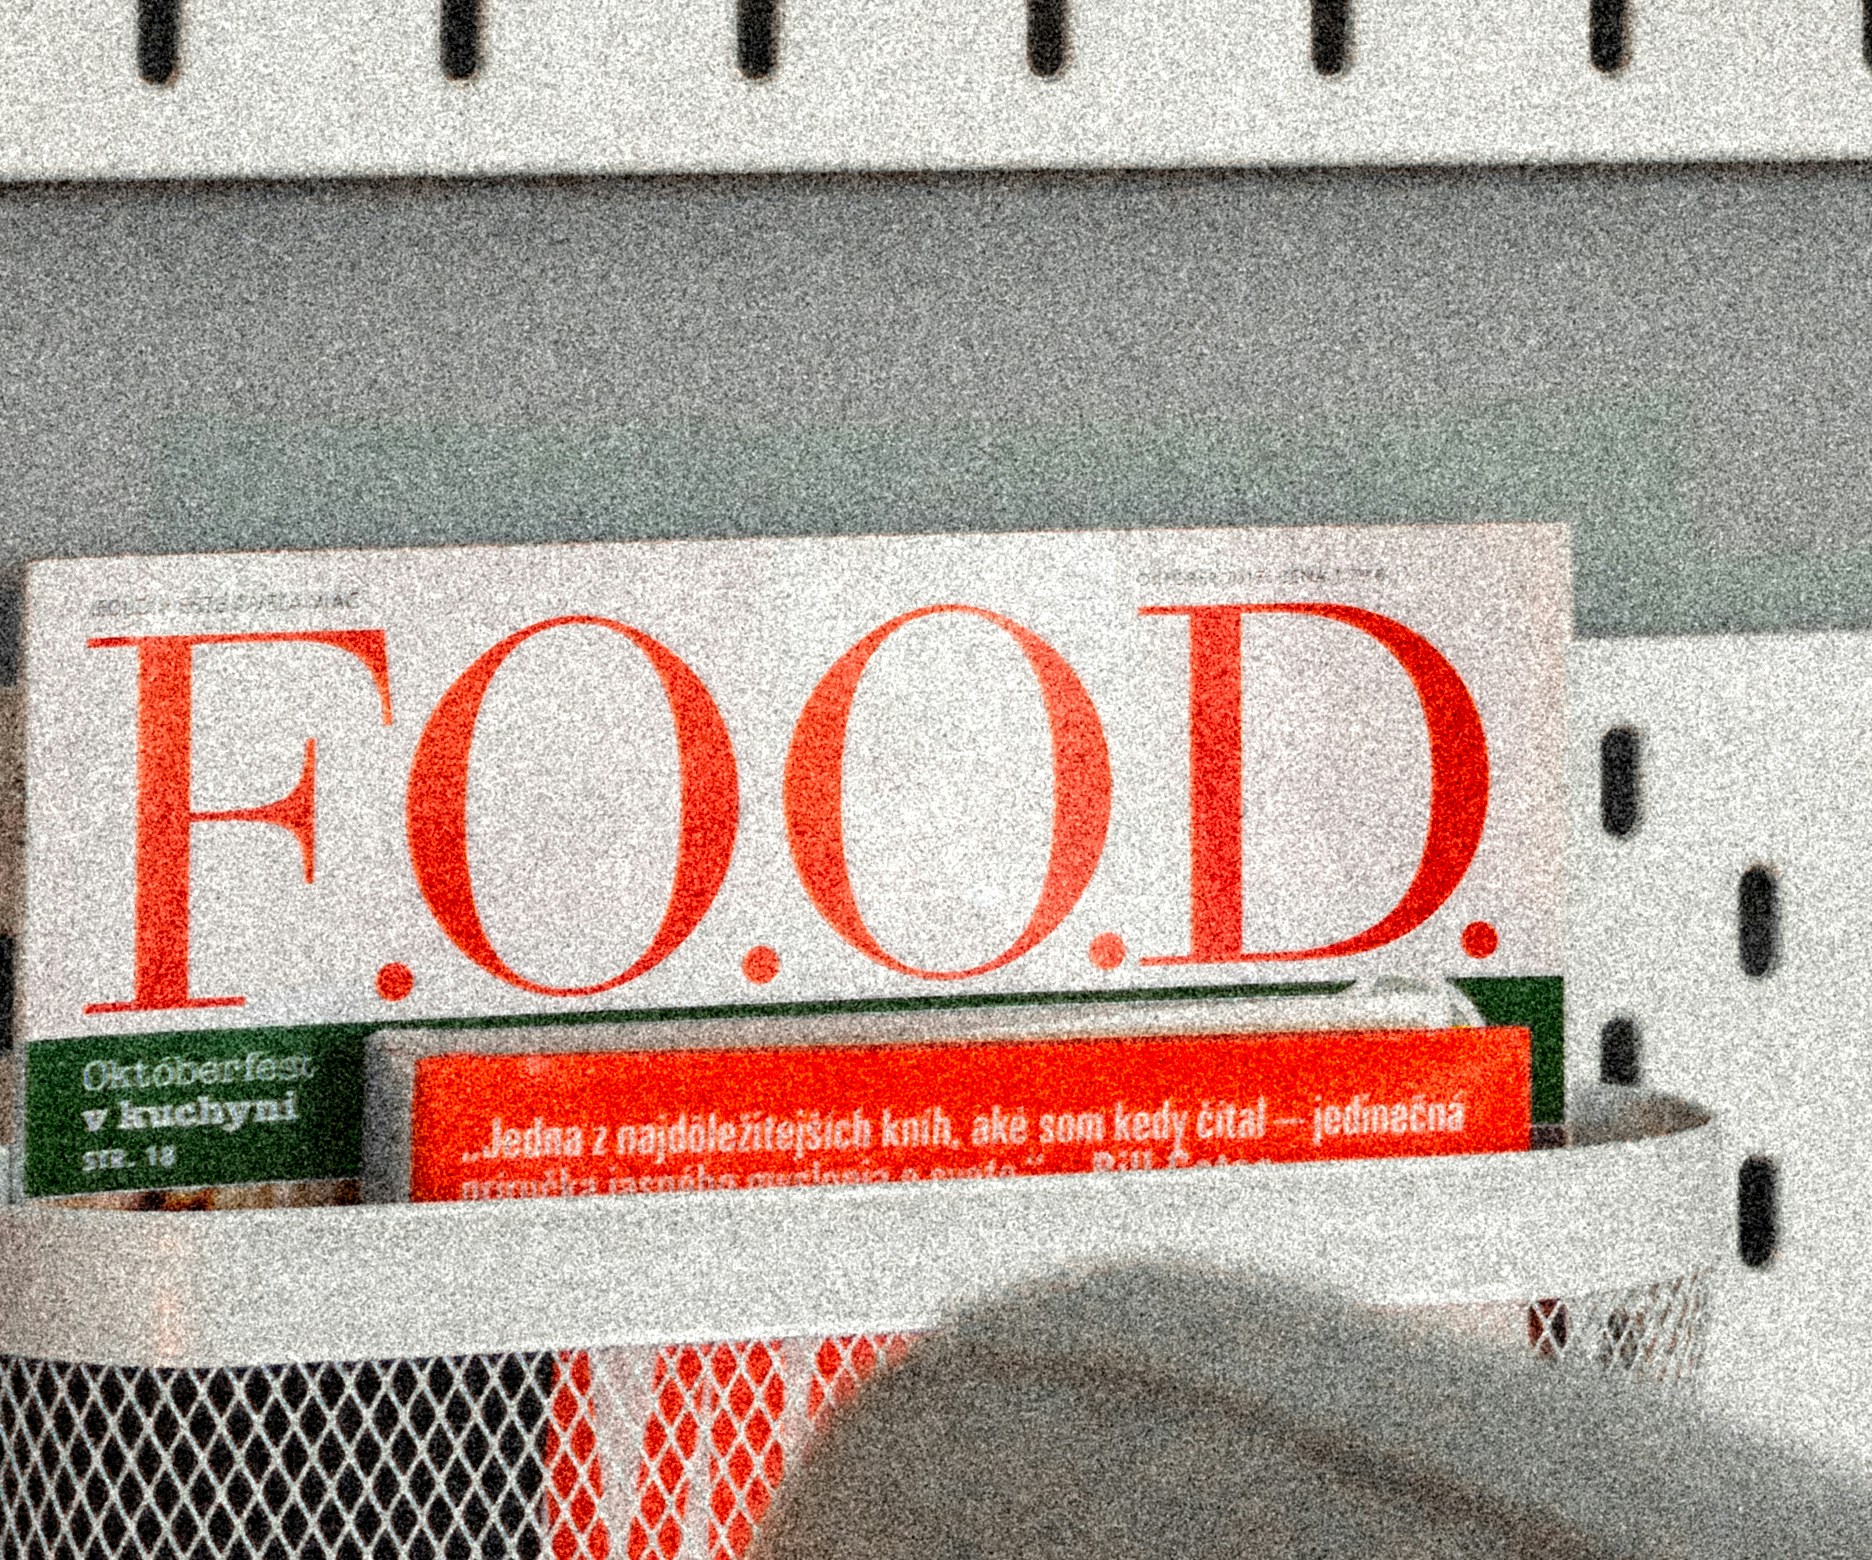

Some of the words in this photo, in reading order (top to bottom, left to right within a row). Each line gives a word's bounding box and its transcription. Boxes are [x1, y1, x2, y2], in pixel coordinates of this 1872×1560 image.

[83, 601, 1499, 1014] F.O.O.D.
[81, 1107, 110, 1132] v
[116, 1090, 301, 1134] kuchyni
[593, 1124, 609, 1156] z
[1040, 1112, 1106, 1144] som
[1114, 1097, 1190, 1156] kedy
[1311, 1090, 1467, 1144] jedinečná
